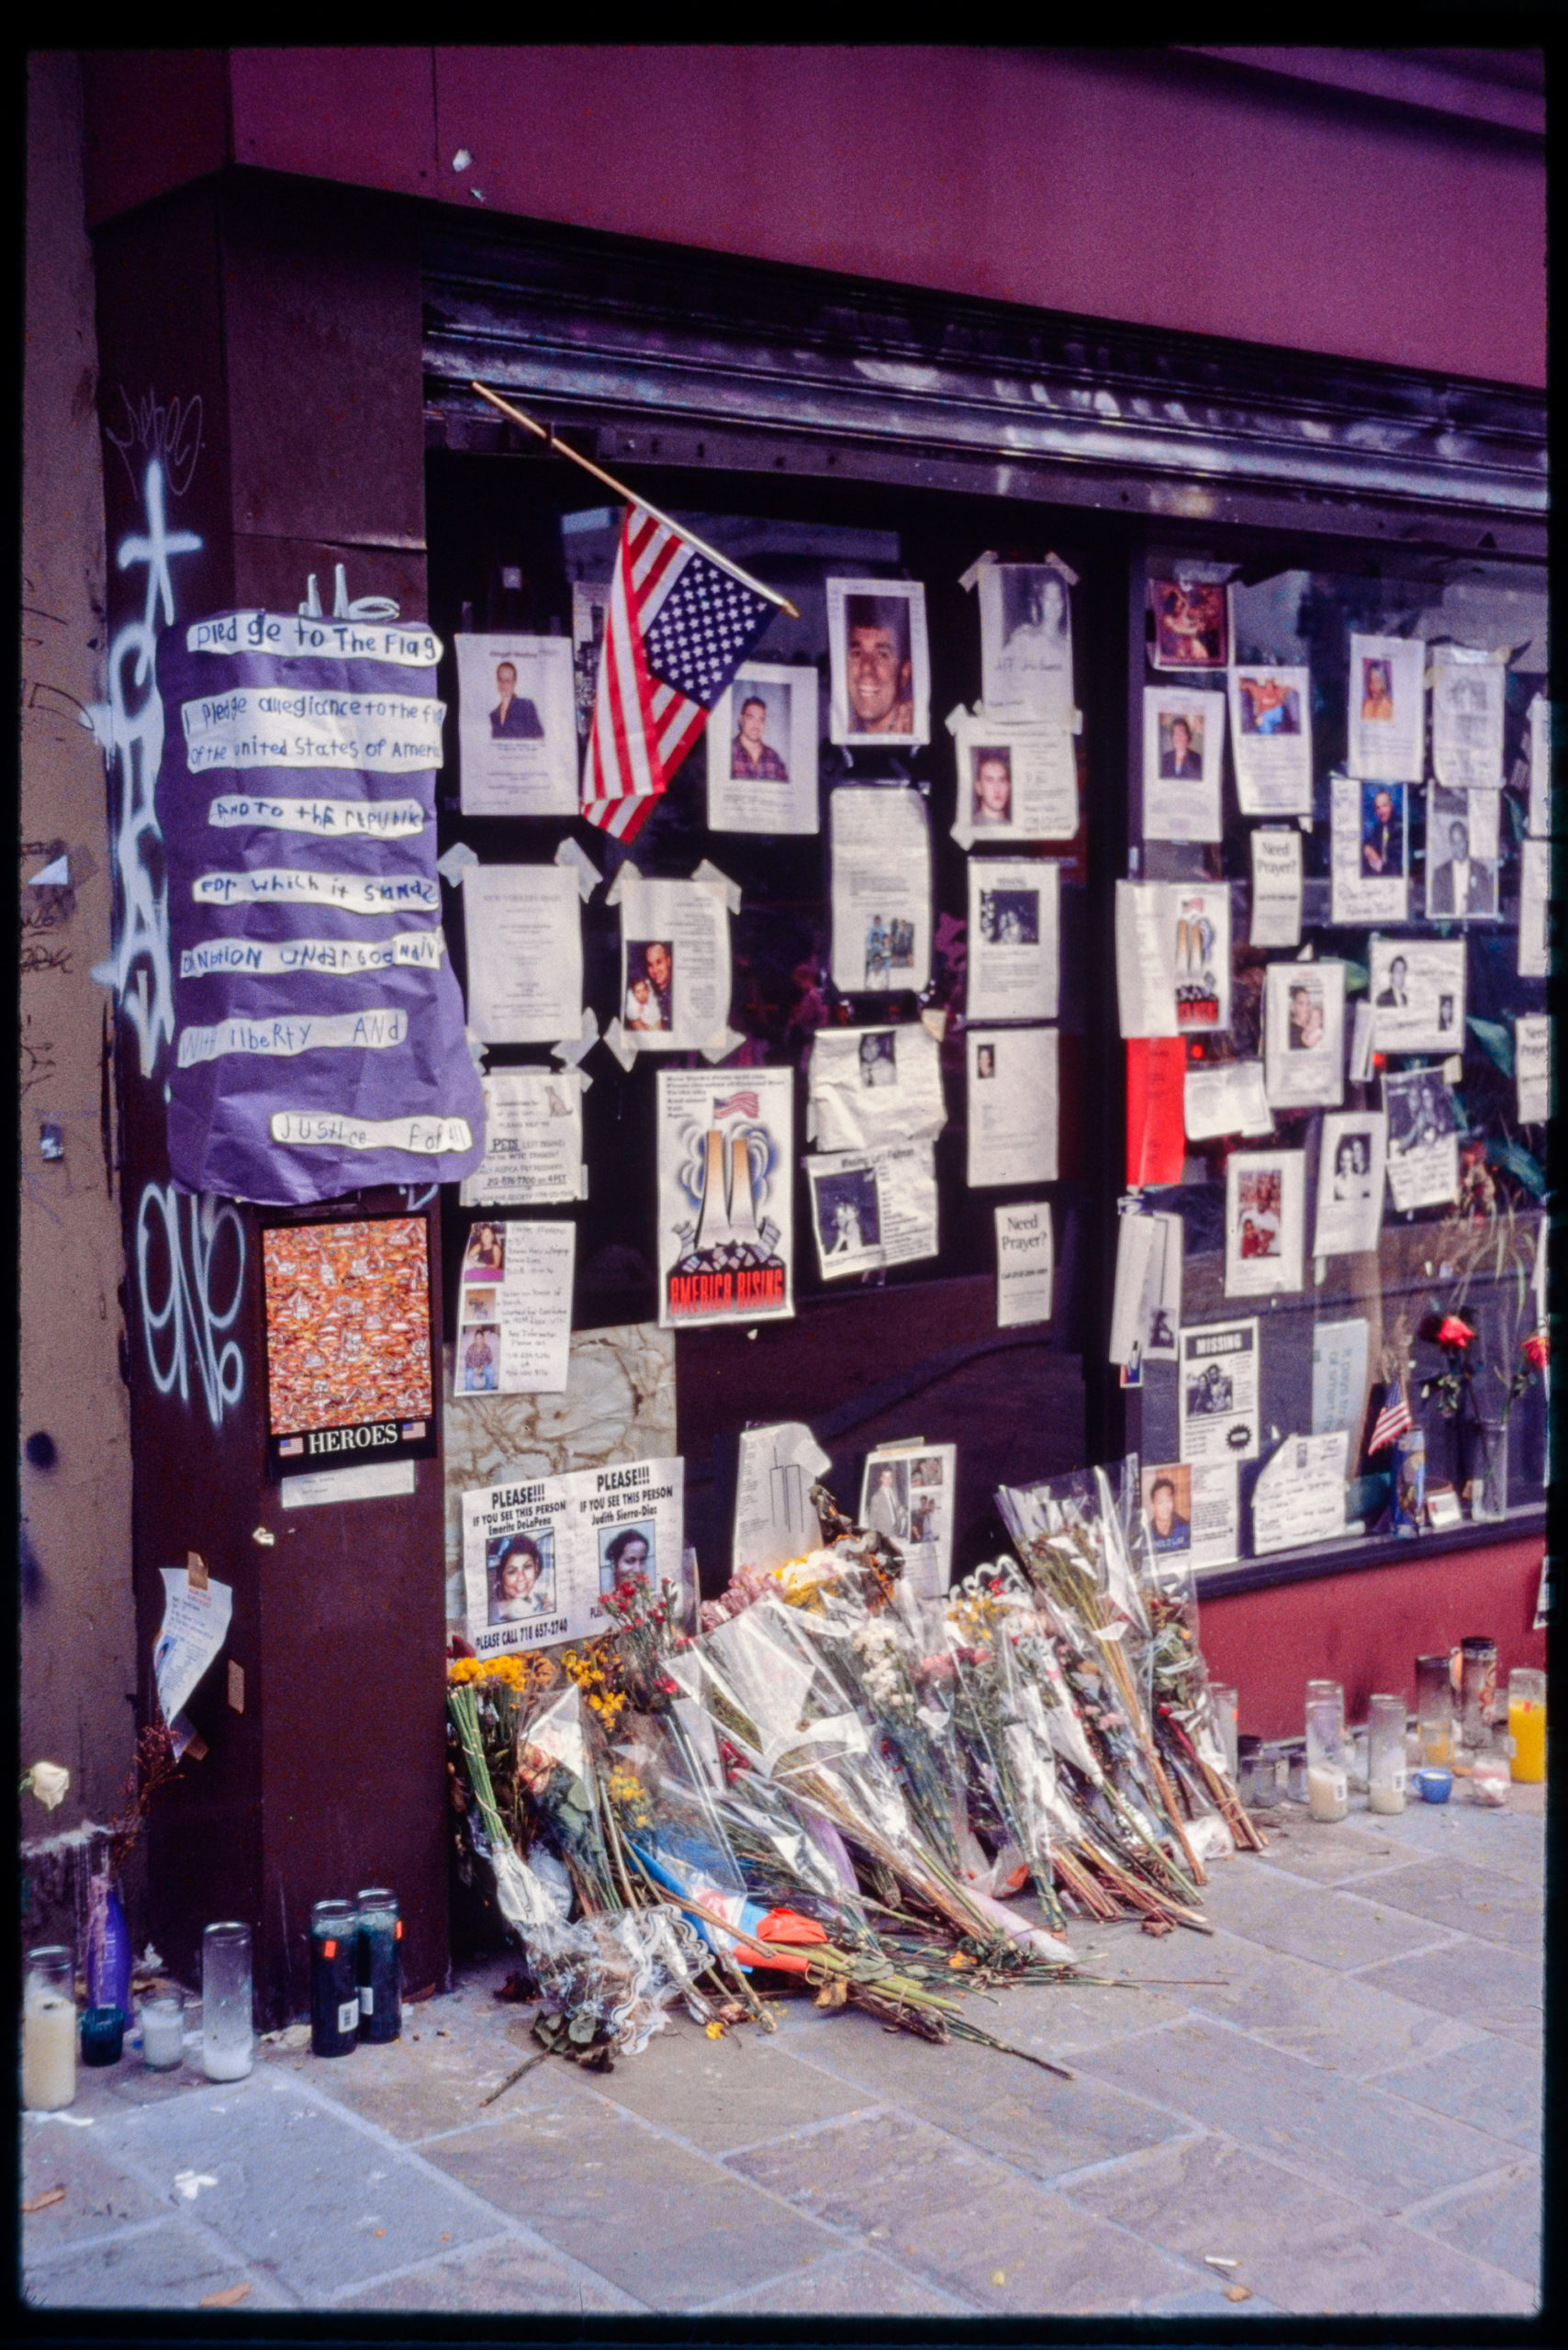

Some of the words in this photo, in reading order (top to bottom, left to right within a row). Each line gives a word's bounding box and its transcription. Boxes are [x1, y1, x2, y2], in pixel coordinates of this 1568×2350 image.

[294, 618, 325, 647] to
[332, 628, 377, 654] The
[384, 632, 437, 660] Flag
[365, 738, 386, 757] of
[1006, 1214, 1038, 1232] Need
[1002, 1231, 1047, 1252] Prayer?
[669, 1270, 733, 1315] AMERICA
[736, 1268, 783, 1308] RISING
[1195, 1332, 1242, 1357] MISSING
[308, 1423, 398, 1454] HEROES
[597, 1466, 650, 1493] PLEASE!!!
[491, 1483, 545, 1510] PLEASE!!!
[579, 1501, 588, 1513] IF
[588, 1497, 605, 1511] YOU
[607, 1494, 621, 1508] SEE
[622, 1491, 640, 1505] THIS
[642, 1485, 673, 1502] PERSON
[473, 1515, 480, 1528] IF
[482, 1512, 499, 1526] YOU
[500, 1510, 514, 1523] SEE
[515, 1506, 533, 1520] THIS
[534, 1501, 566, 1518] PERSON
[591, 1510, 614, 1526] Judith
[476, 1631, 501, 1651] PLEASE
[502, 1627, 519, 1646] CALL
[521, 1625, 533, 1642] 718
